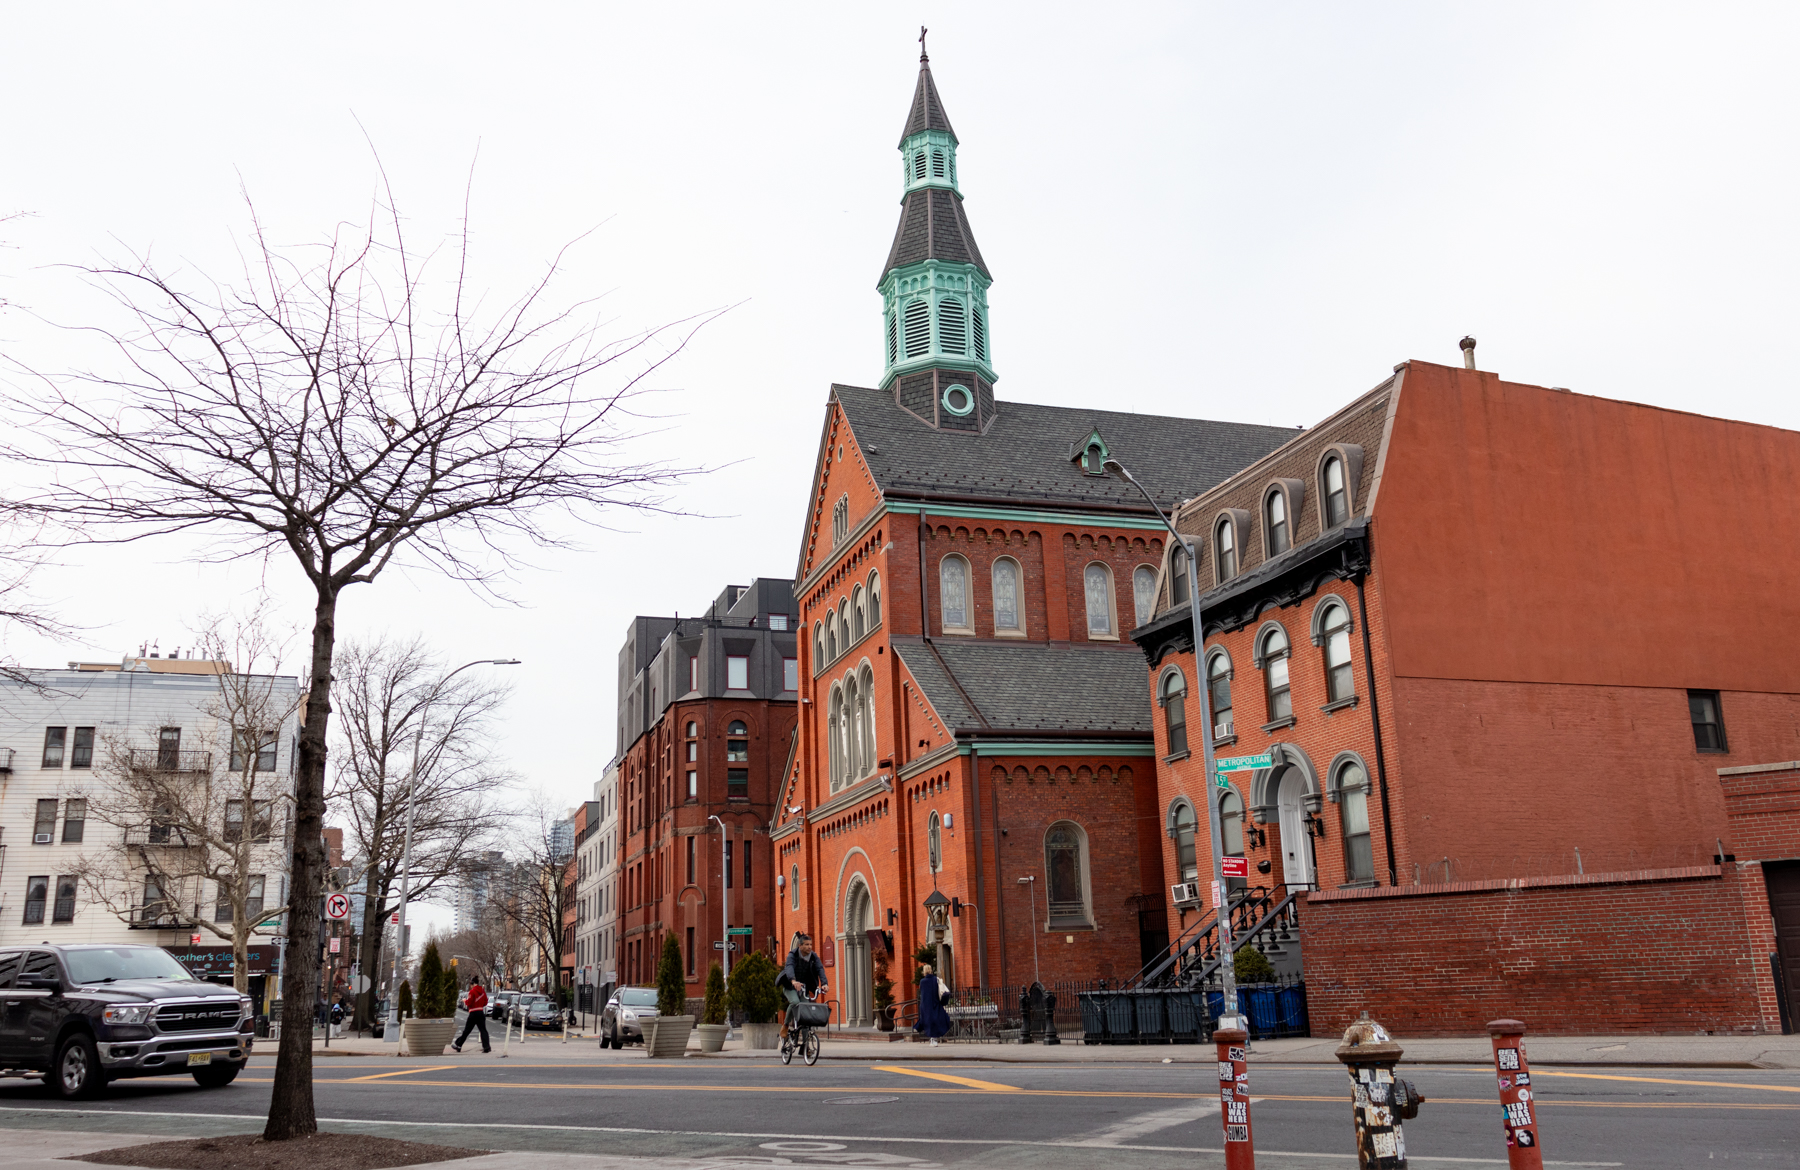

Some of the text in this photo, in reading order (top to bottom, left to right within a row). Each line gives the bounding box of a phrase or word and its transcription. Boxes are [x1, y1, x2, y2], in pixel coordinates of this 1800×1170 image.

[1218, 756, 1270, 767] METROPOLITAN
[173, 952, 260, 961] rother's cleaers
[1228, 1108, 1246, 1116] WAS
[1506, 1102, 1528, 1112] TEDZ
[1228, 1115, 1247, 1123] HERE
[1508, 1109, 1530, 1119] WAS
[1510, 1117, 1532, 1127] HERE
[1228, 1126, 1247, 1140] GUMBA
